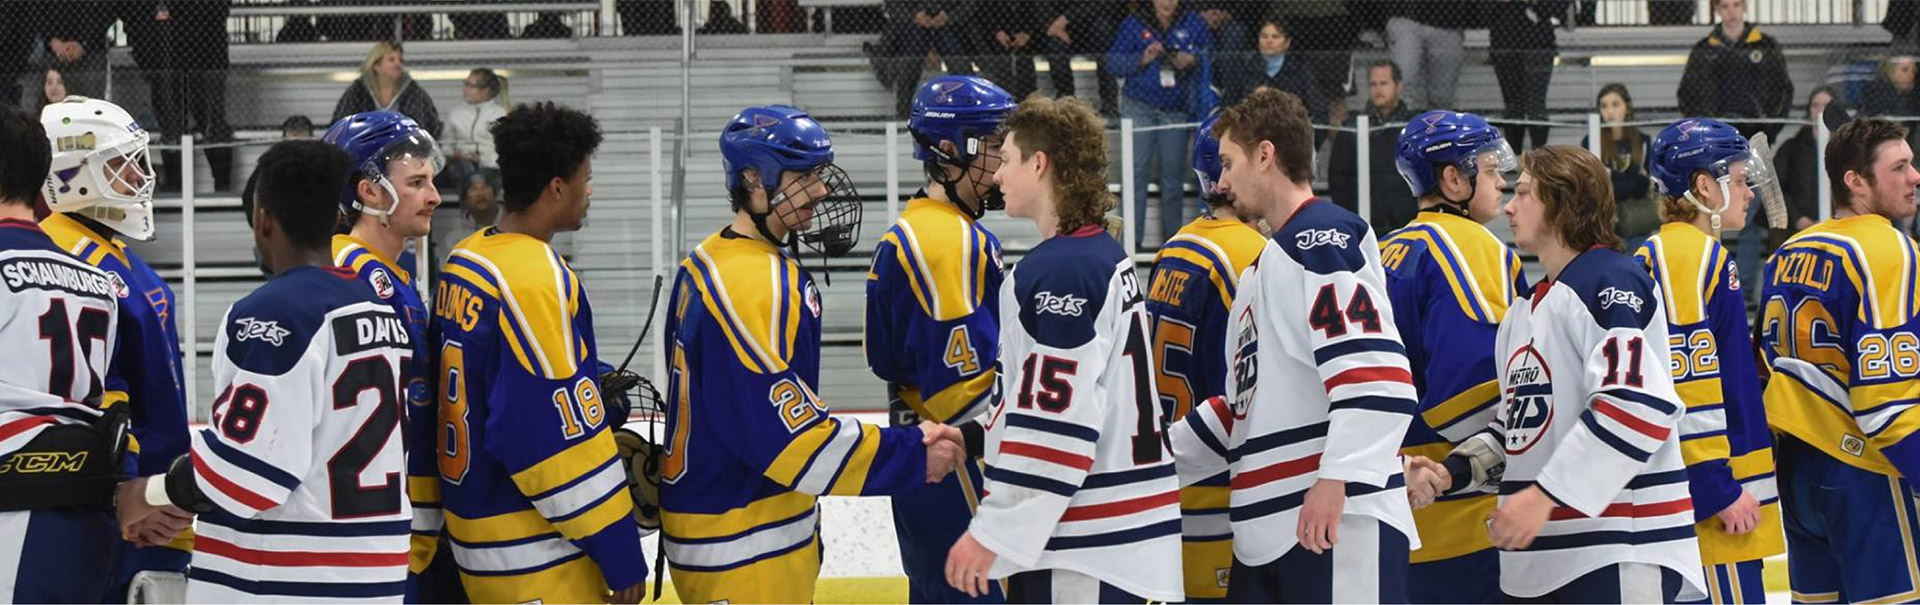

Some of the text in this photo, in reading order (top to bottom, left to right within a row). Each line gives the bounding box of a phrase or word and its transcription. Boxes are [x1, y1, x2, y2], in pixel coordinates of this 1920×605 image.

[1295, 228, 1351, 249] Jets
[1034, 291, 1088, 317] Jets
[1308, 282, 1383, 340] 44
[1598, 287, 1644, 313] Jets
[235, 317, 292, 346] Jets
[943, 324, 981, 377] 4
[1857, 331, 1920, 380] 26
[1017, 352, 1078, 414] 15
[1601, 336, 1644, 388] 11
[552, 376, 606, 440] 18
